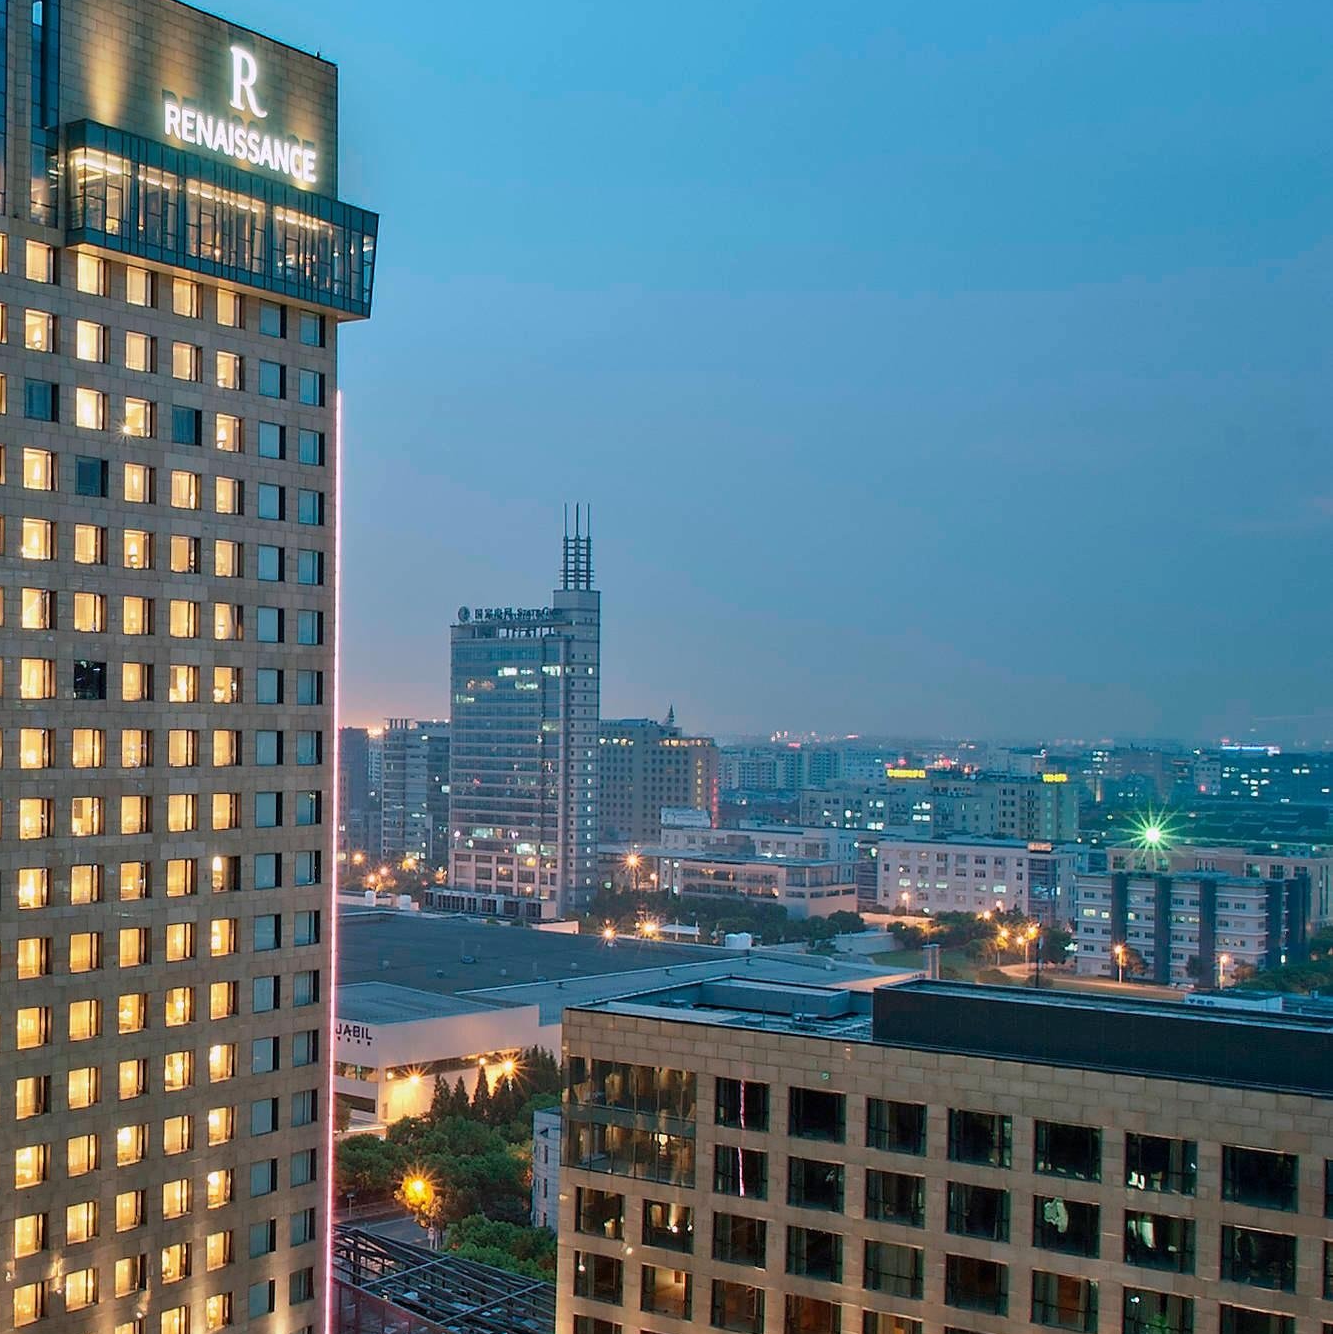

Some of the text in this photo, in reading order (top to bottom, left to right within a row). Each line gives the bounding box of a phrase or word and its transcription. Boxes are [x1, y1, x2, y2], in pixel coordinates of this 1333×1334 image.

[230, 46, 267, 118] R
[164, 101, 316, 183] RENAISSANCE
[335, 1023, 373, 1040] JABIL
